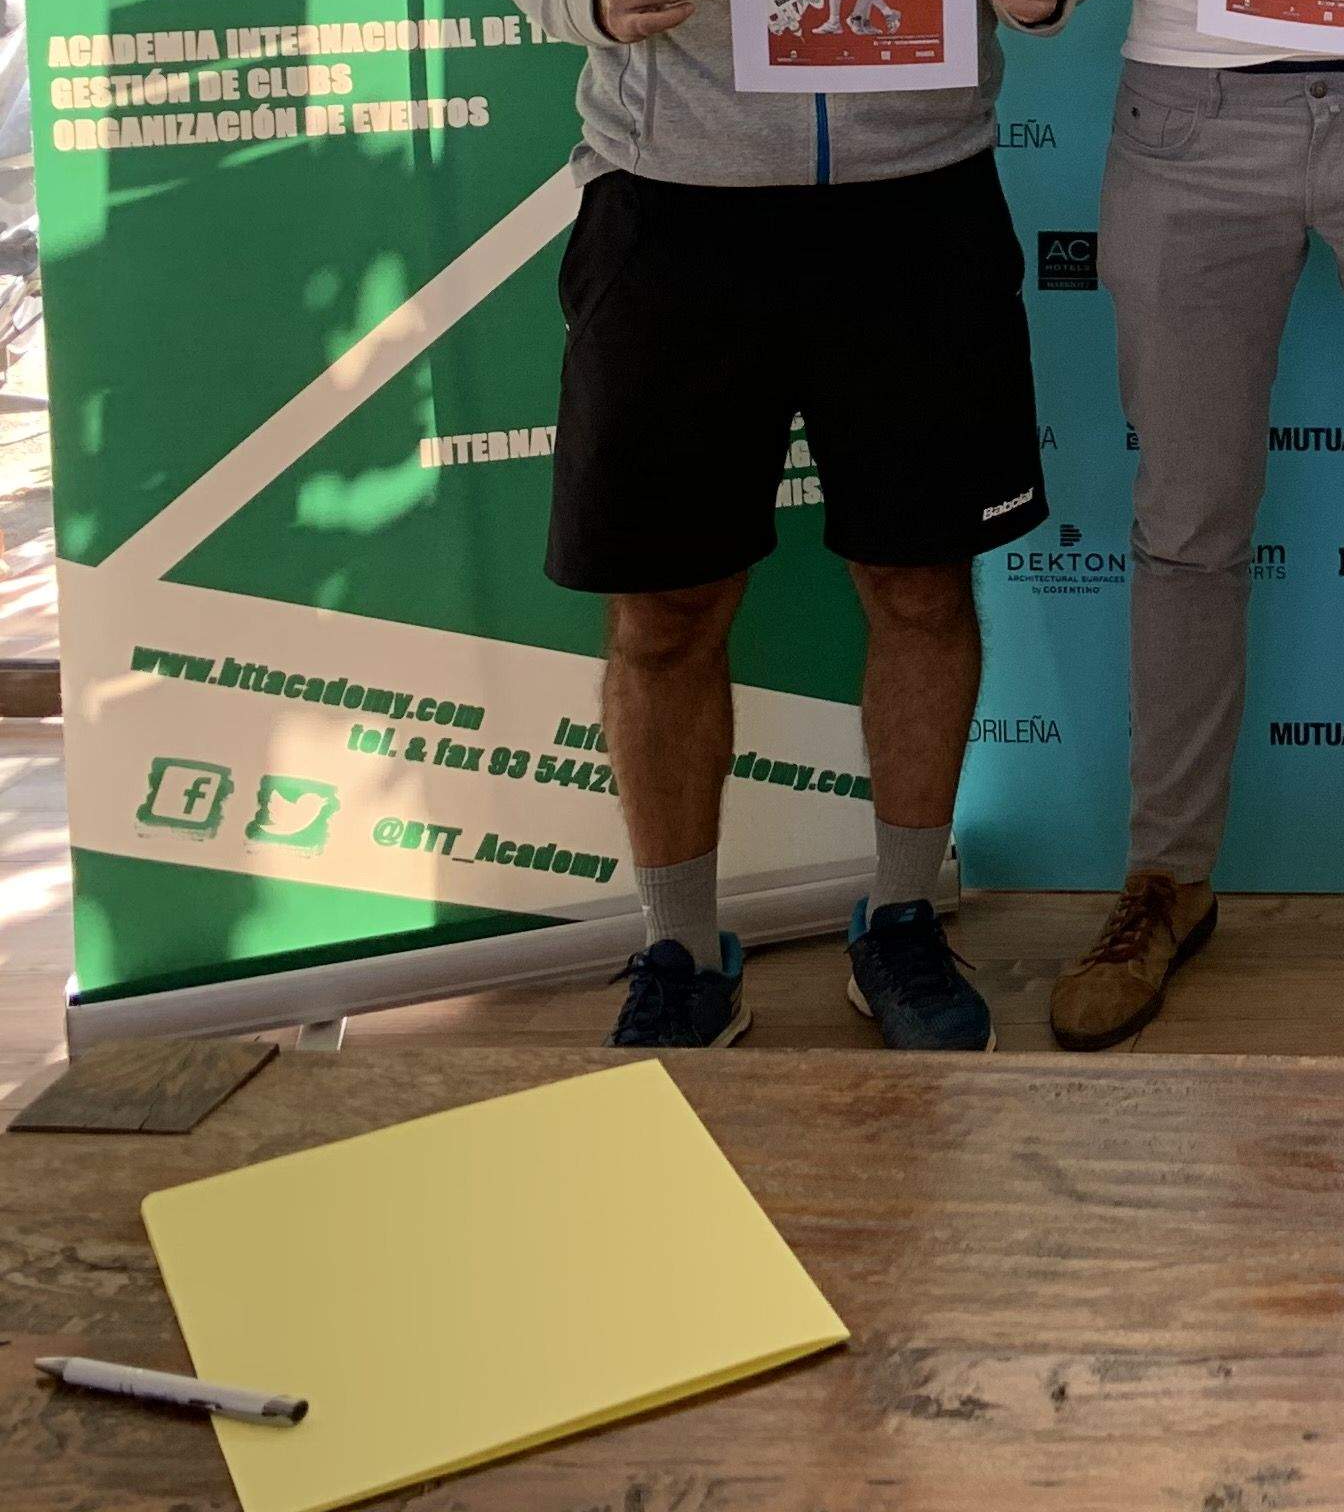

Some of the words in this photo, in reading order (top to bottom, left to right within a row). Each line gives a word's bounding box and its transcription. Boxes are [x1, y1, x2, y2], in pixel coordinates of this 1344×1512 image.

[48, 28, 220, 68] ACADEMIA
[227, 17, 476, 59] INTERNACIONAL
[482, 15, 522, 47] DE
[50, 69, 192, 109] GESTIÓN
[198, 69, 240, 102] DE
[247, 64, 353, 97] CLUBS
[53, 103, 299, 151] ORGANIZACIÓN
[305, 105, 346, 136] DE
[352, 96, 490, 133] EVENTOS
[419, 425, 557, 468] INTERNAT
[1007, 552, 1126, 571] DEKTON
[130, 645, 486, 730] www.bttacademy.com
[346, 723, 397, 757] tel.
[404, 736, 428, 763] &
[433, 737, 485, 772] fax
[487, 746, 531, 780] 93
[372, 816, 620, 884] @BTT_Academy
